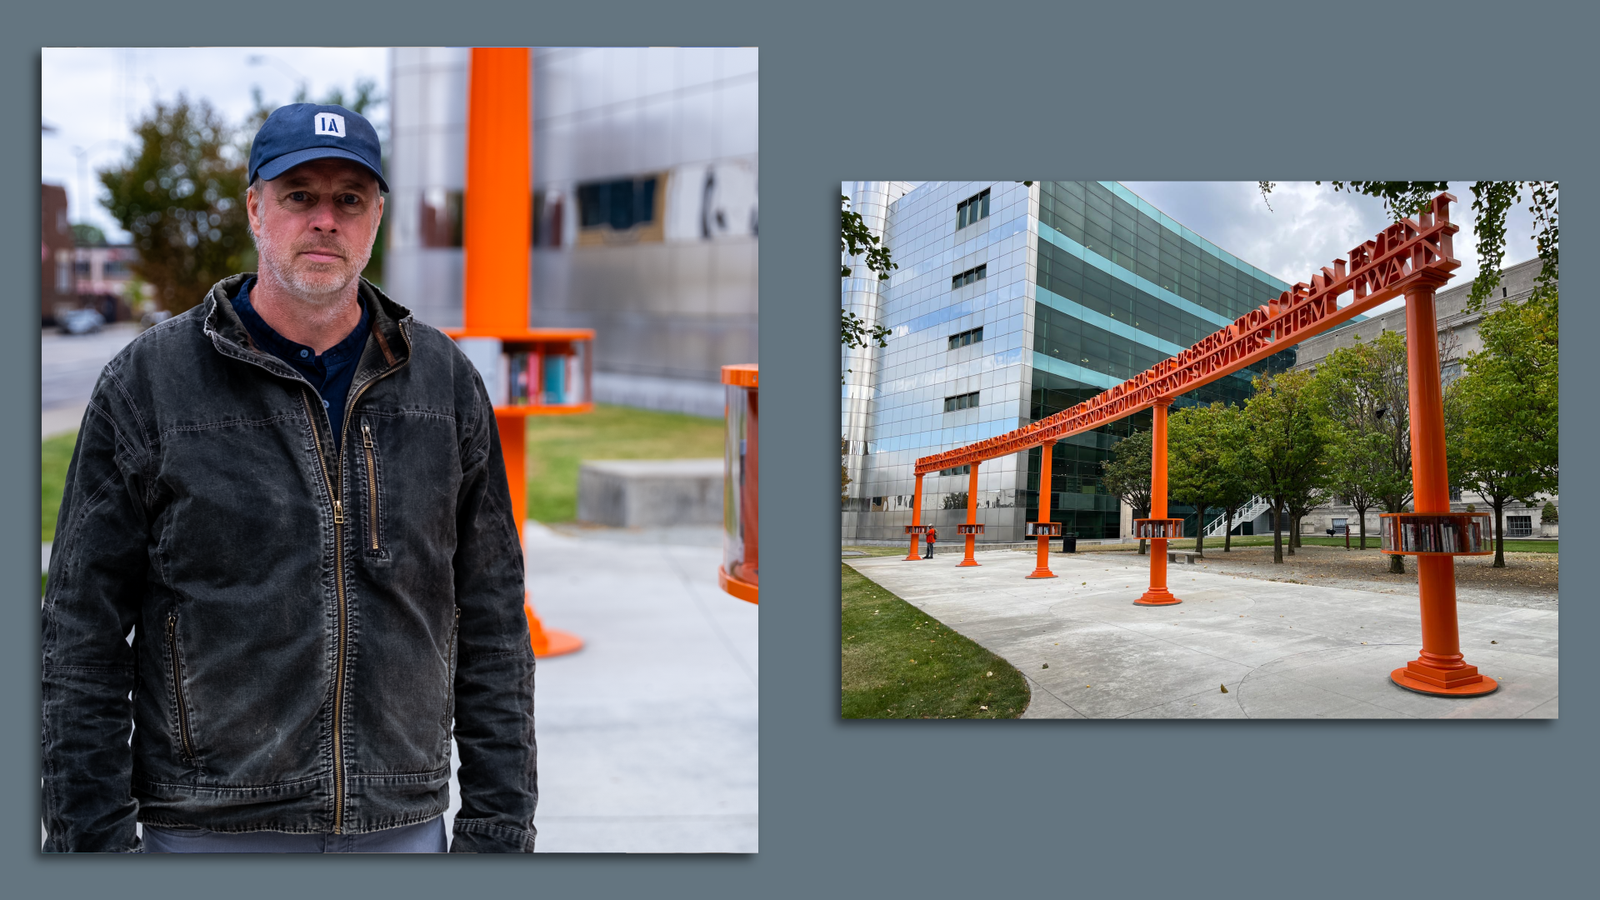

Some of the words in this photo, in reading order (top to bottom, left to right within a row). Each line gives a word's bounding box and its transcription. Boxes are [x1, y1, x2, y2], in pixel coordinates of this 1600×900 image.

[321, 117, 339, 133] IA
[1085, 408, 1102, 426] AND
[1102, 380, 1163, 418] REVOLUTIONS
[1165, 367, 1191, 393] AND
[1193, 330, 1266, 379] SURVIVES
[1270, 292, 1337, 341] THEM
[1347, 232, 1453, 302] TWAIN
[1086, 379, 1134, 410] MONUMENT
[1134, 369, 1154, 389] FOR
[1152, 357, 1177, 380] THE
[1177, 298, 1279, 369] PRESERVATION
[1279, 282, 1309, 313] OF
[1308, 258, 1347, 297] AN
[1347, 192, 1457, 276] EVENT
